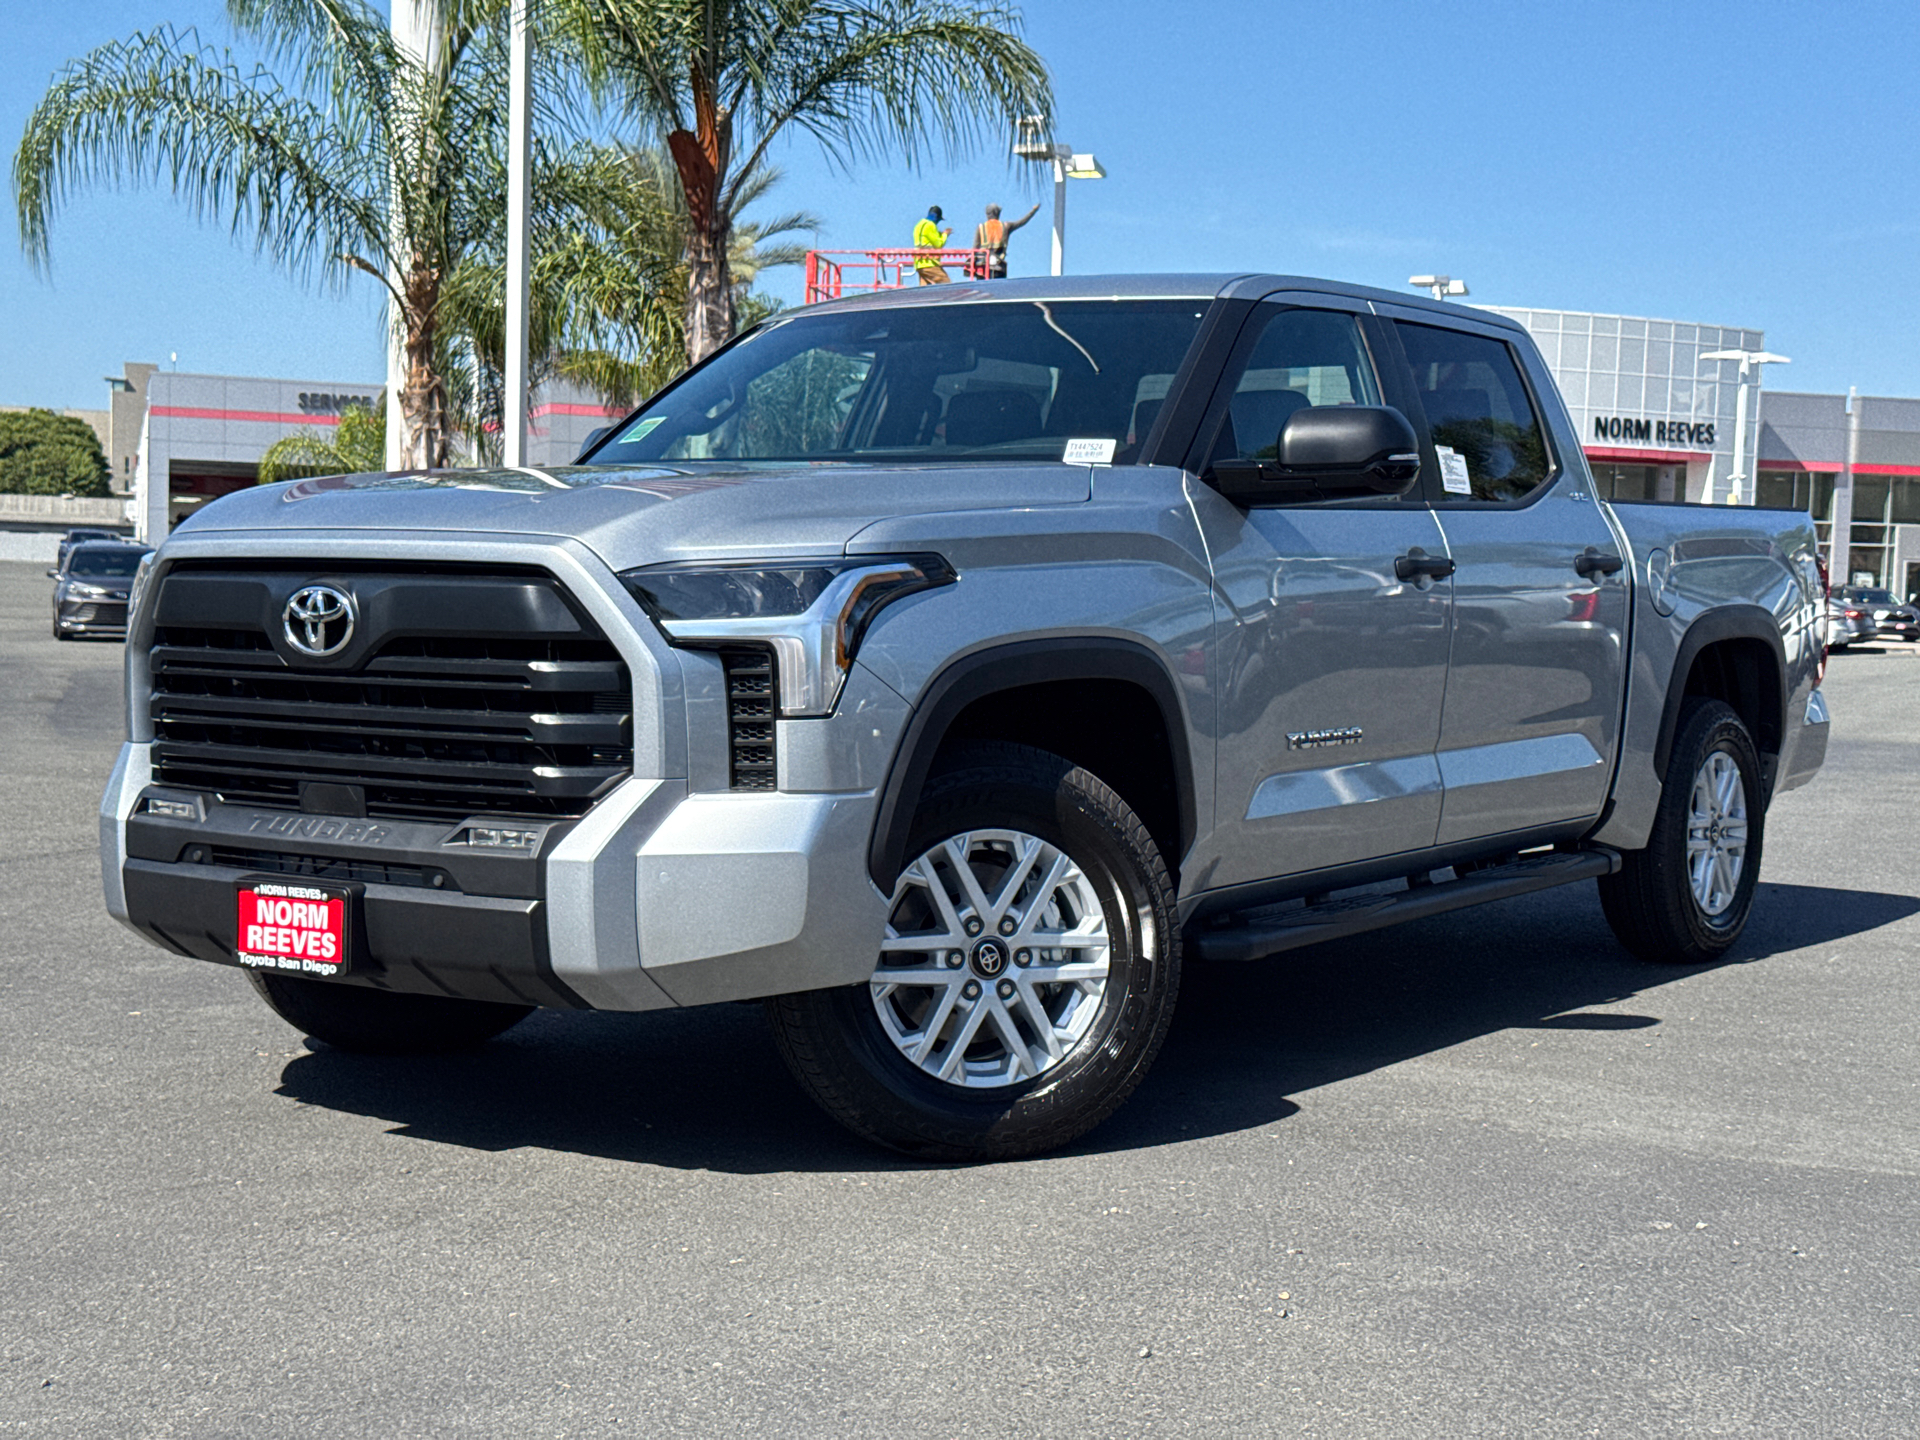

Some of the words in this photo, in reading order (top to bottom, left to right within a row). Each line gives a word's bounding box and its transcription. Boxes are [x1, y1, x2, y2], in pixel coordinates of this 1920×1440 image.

[1594, 416, 1651, 441] NORM
[1656, 420, 1715, 445] REEVES
[249, 813, 392, 844] TUNDRA
[259, 883, 288, 897] NORM
[288, 886, 322, 900] REEVES
[256, 899, 329, 930] NORM
[247, 924, 336, 958] REEVES
[238, 951, 276, 970] Toyota
[277, 956, 301, 970] San
[302, 959, 338, 976] Diego
